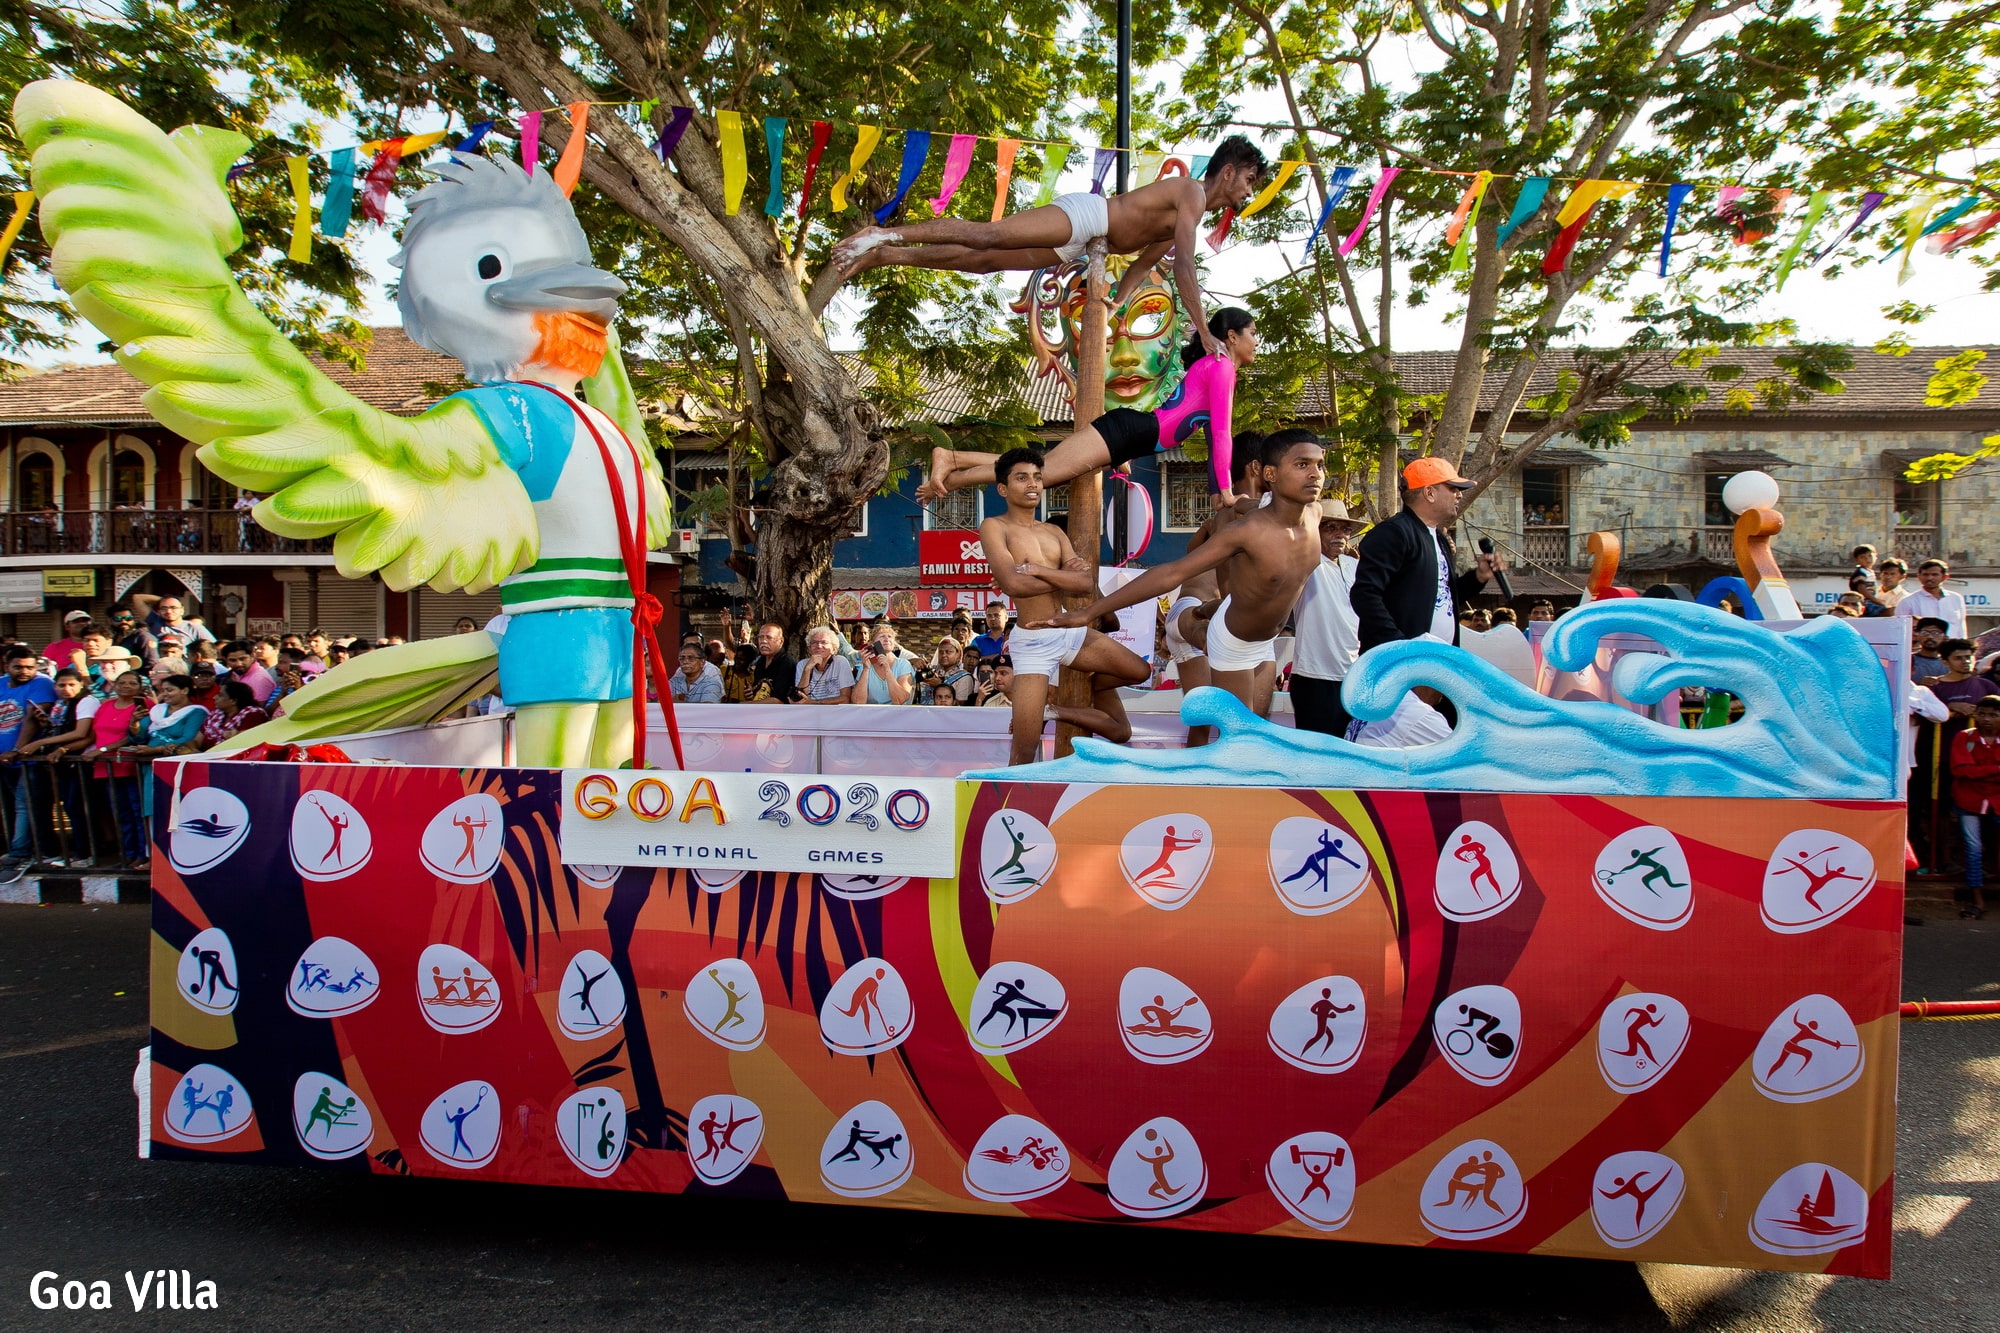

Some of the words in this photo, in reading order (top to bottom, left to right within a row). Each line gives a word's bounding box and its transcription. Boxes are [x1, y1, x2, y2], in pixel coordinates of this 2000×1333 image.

[922, 563, 960, 574] FAMILY
[964, 563, 992, 574] REST
[957, 591, 1017, 610] SIM
[1815, 592, 1842, 603] DEN
[1964, 594, 1991, 605] LTD.
[574, 774, 729, 826] GOA
[757, 779, 931, 833] 2020
[638, 844, 759, 861] NATIONAL
[808, 850, 884, 865] GAMES
